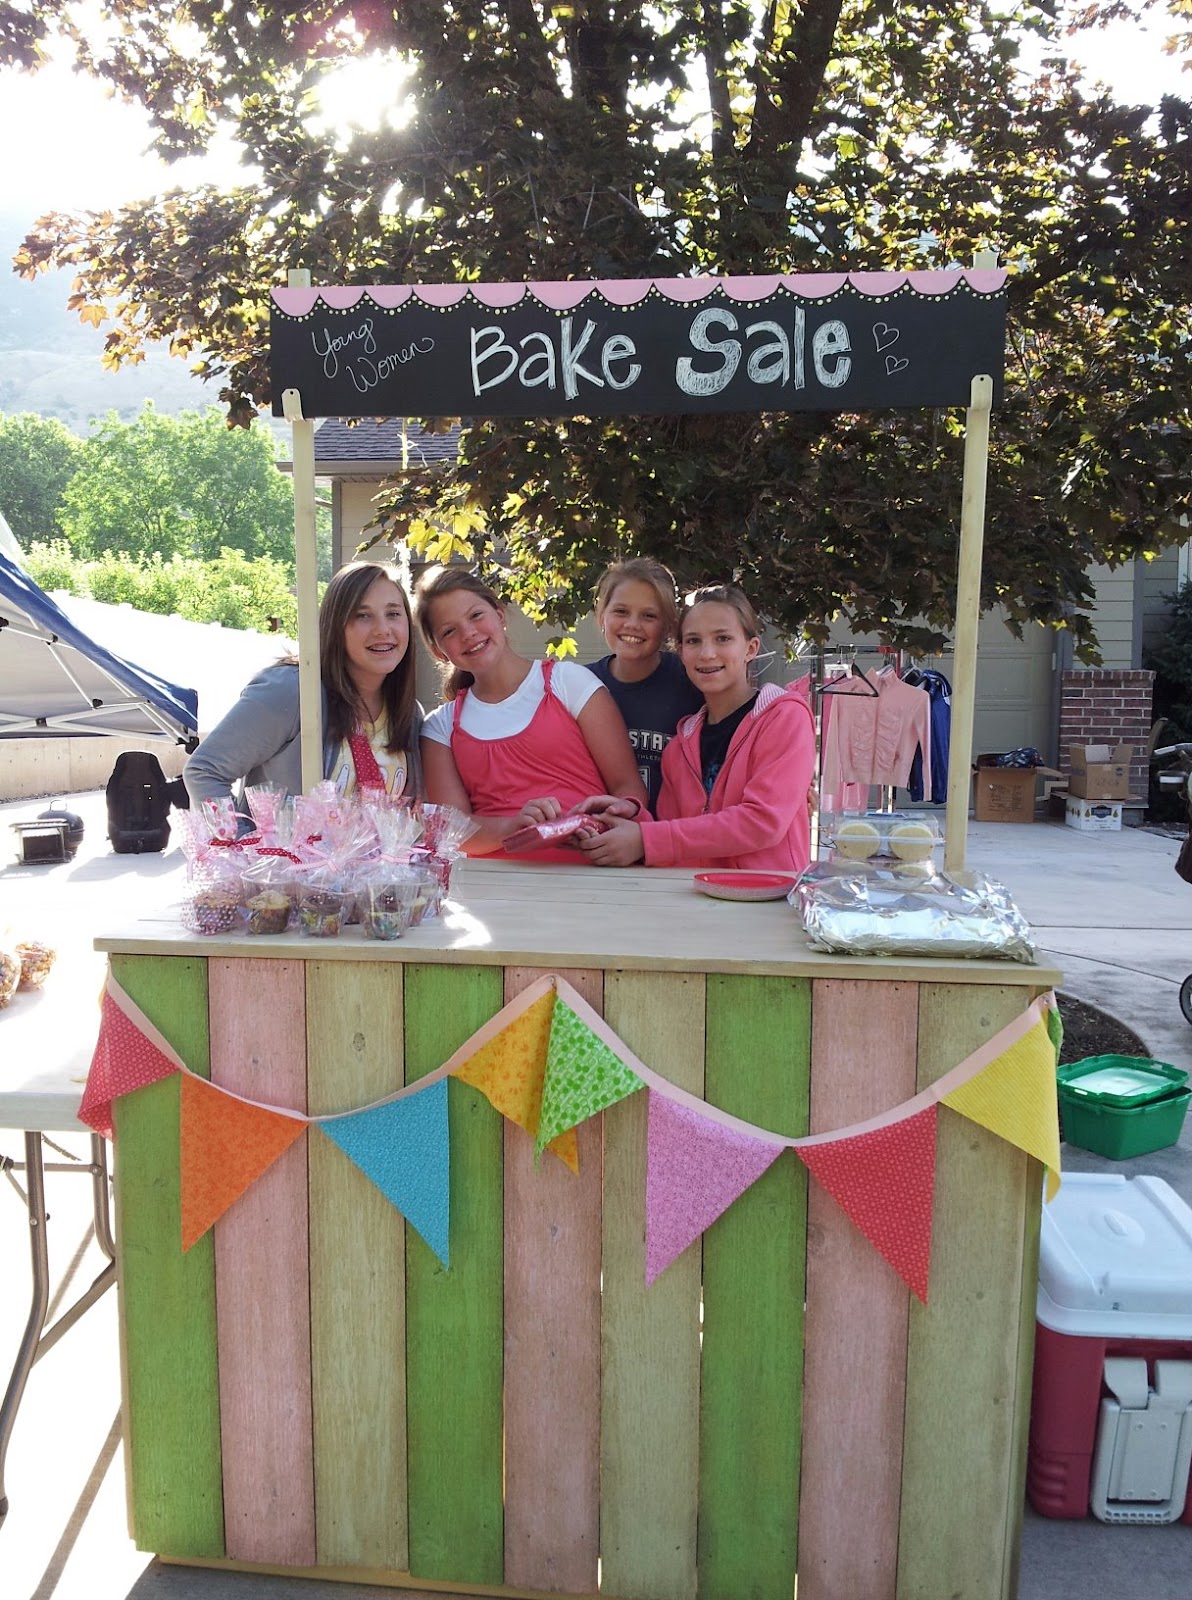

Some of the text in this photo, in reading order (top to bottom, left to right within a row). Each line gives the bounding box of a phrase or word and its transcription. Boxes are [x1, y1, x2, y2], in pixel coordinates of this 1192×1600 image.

[311, 317, 377, 379] Young
[345, 337, 435, 393] Women
[470, 305, 852, 401] Bake Sale
